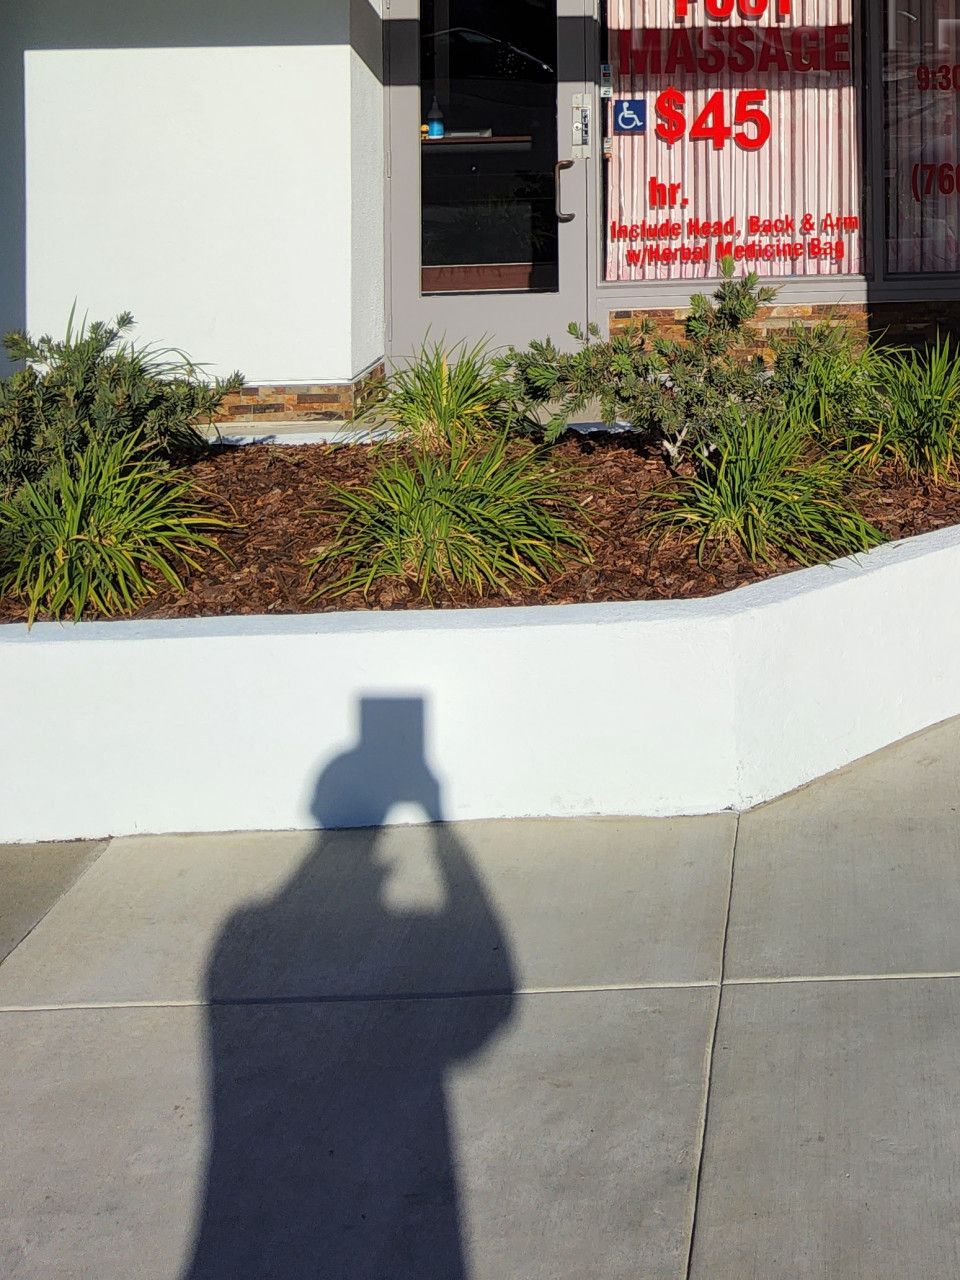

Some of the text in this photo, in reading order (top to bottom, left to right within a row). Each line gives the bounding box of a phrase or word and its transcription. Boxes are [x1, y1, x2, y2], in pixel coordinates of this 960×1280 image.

[618, 25, 850, 75] MASSAGE
[655, 86, 771, 151] $45
[649, 176, 689, 206] hr.
[610, 212, 859, 239] Include Head, Back & Arm
[625, 237, 845, 268] w/Herbal Medicine Bag
